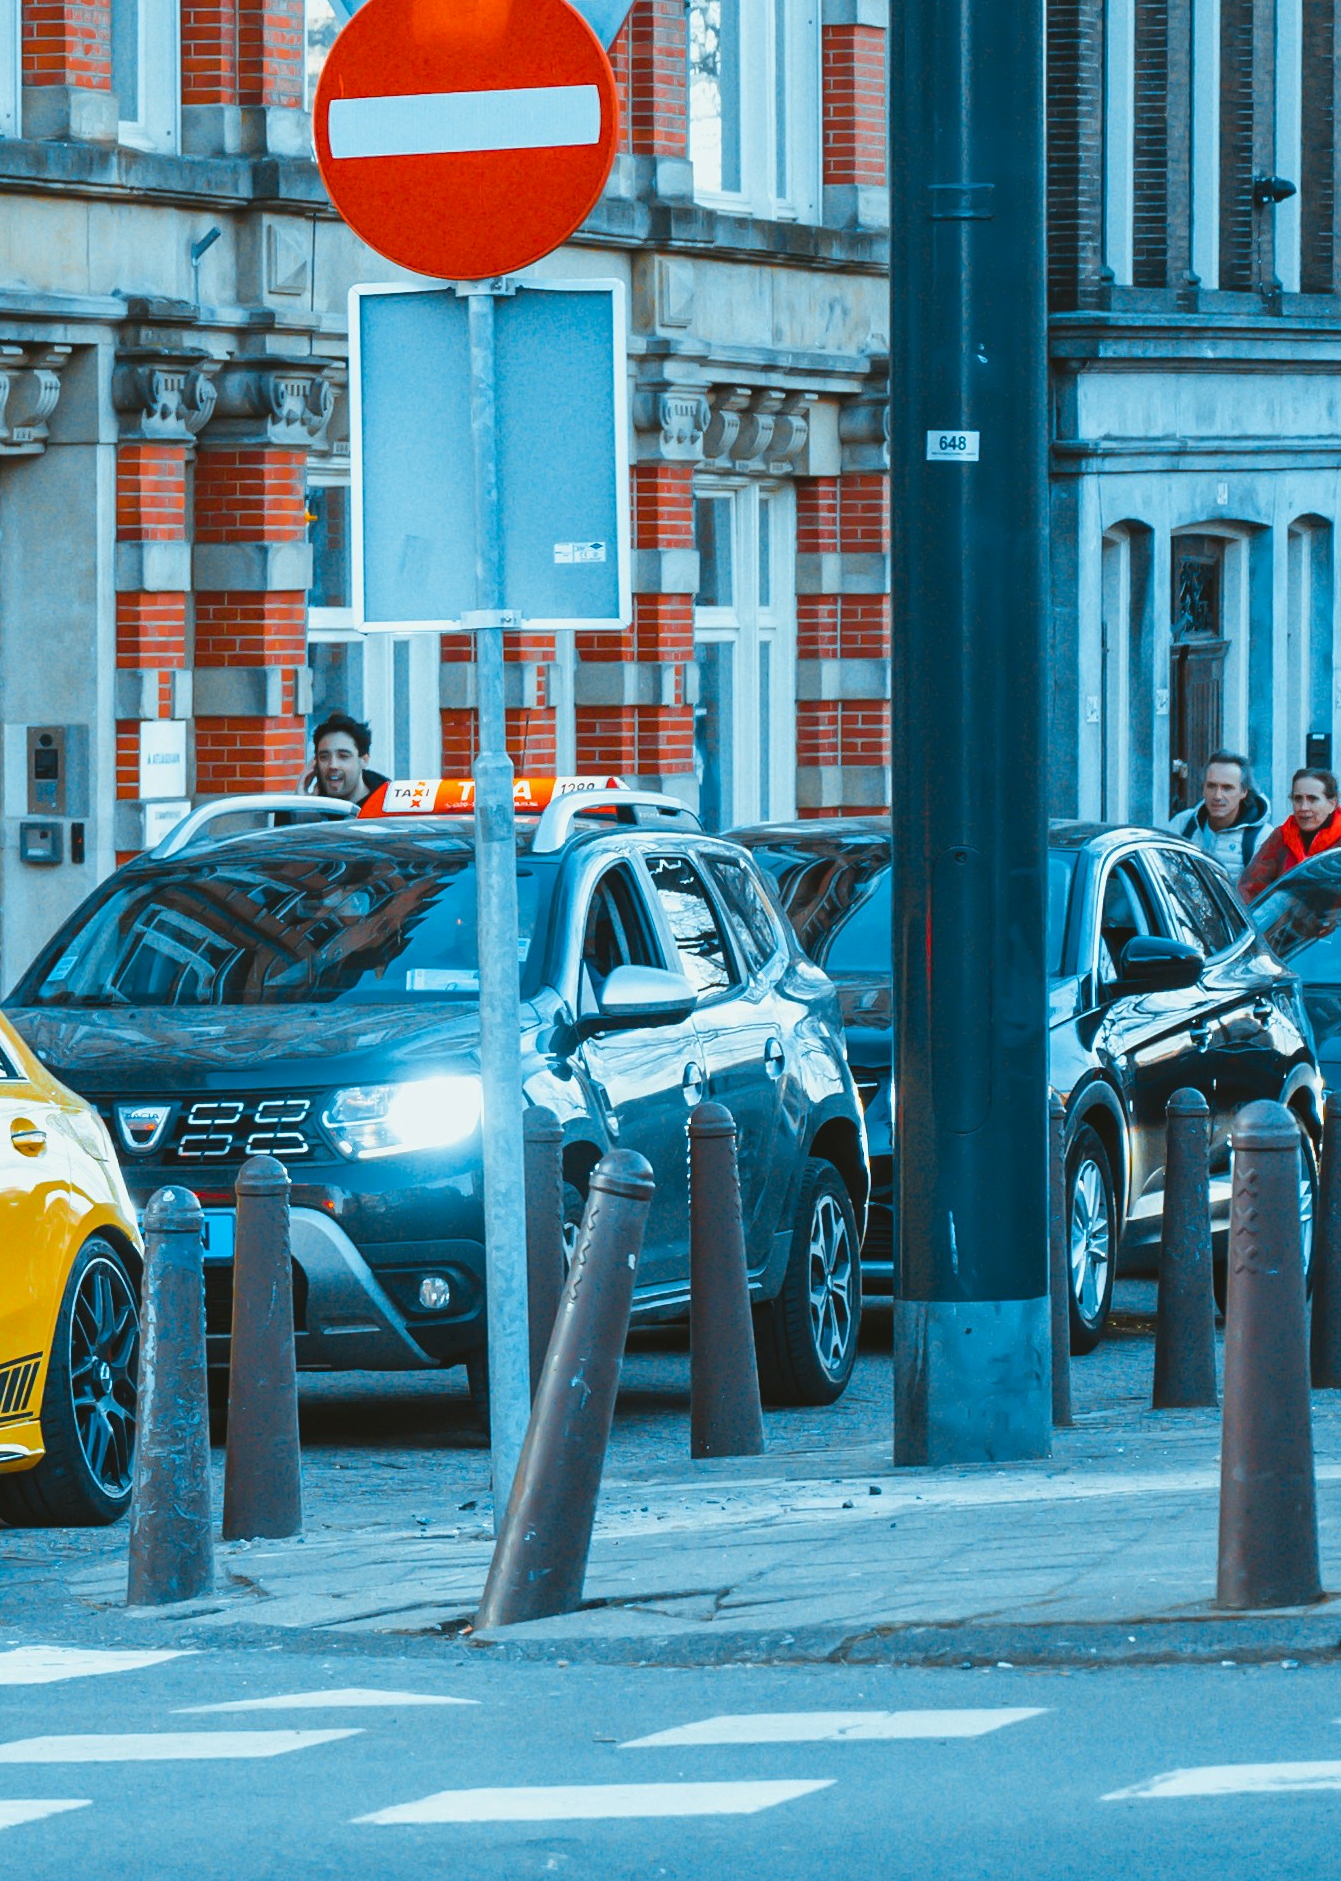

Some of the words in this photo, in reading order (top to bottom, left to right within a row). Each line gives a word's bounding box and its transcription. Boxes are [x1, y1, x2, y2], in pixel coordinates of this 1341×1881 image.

[939, 435, 967, 451] 648
[394, 788, 430, 797] TAXI
[458, 780, 531, 801] TA
